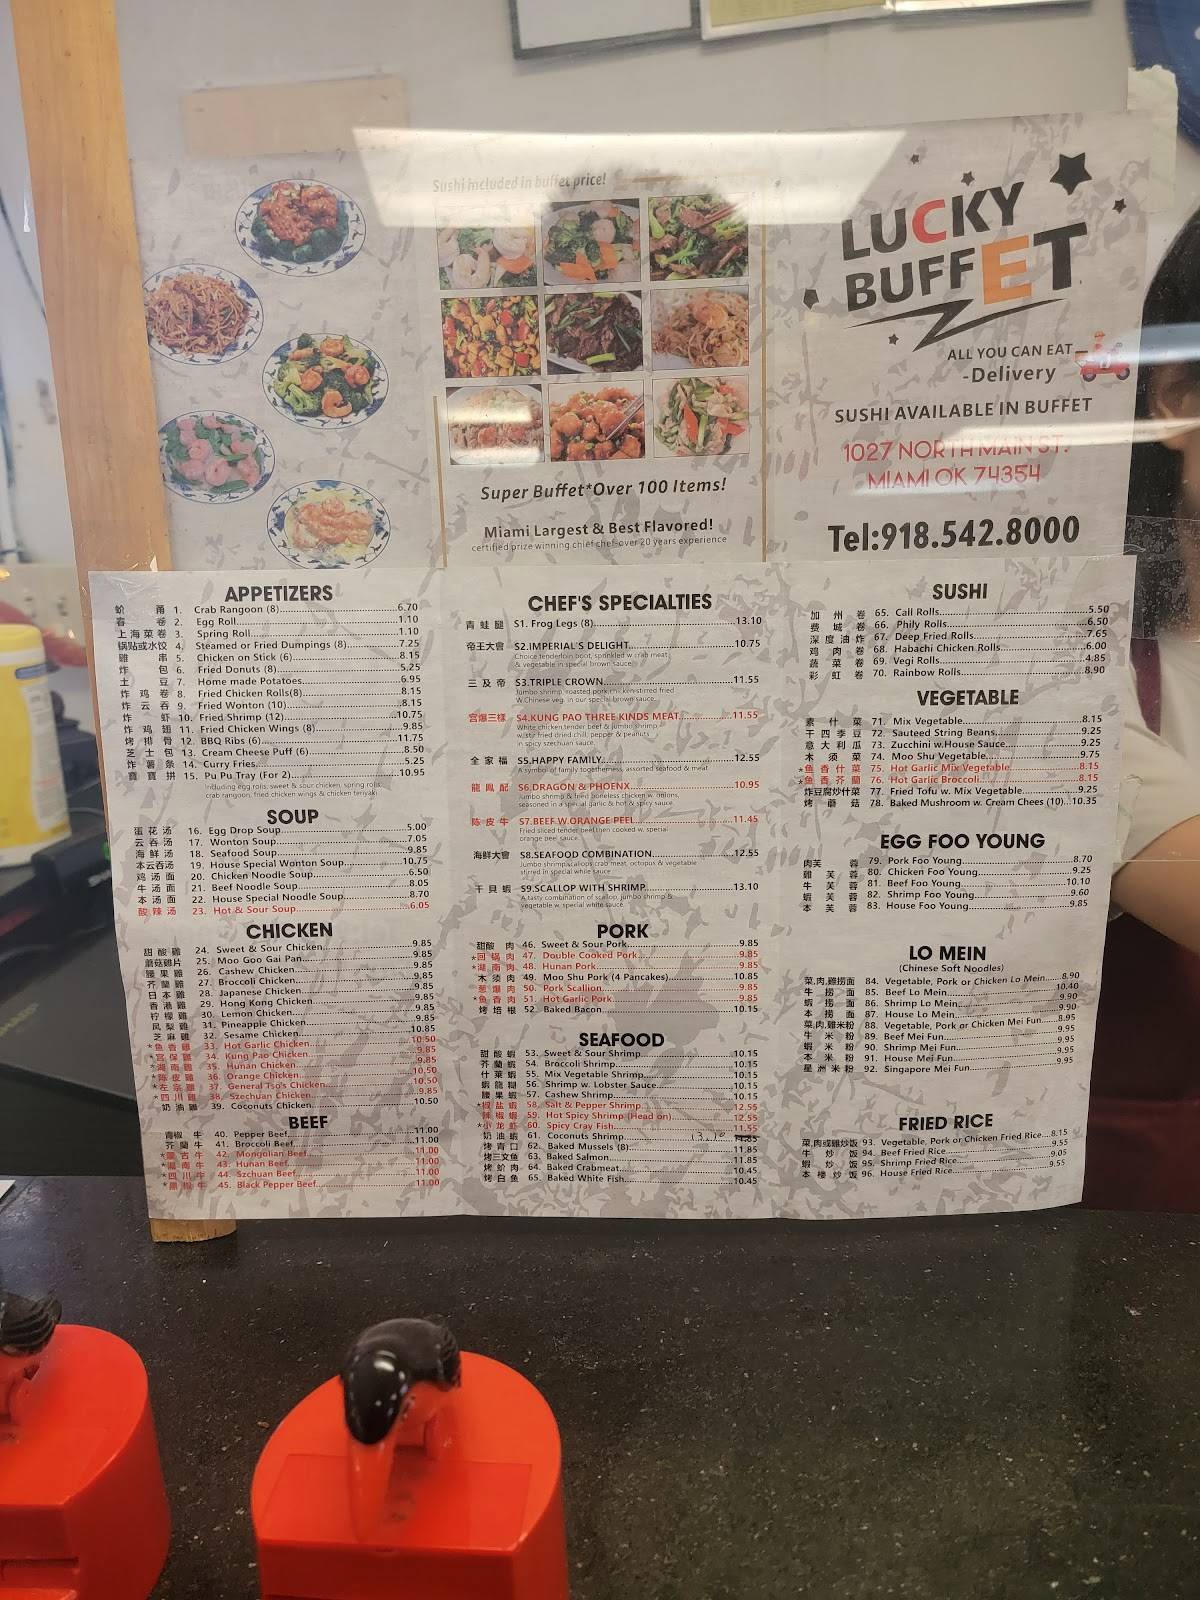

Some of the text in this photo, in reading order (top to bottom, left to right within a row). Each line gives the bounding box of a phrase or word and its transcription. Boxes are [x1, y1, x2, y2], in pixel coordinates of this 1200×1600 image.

[433, 178, 465, 193] Sushi
[467, 176, 518, 191] included
[521, 176, 532, 189] in
[573, 173, 607, 190] price!
[842, 182, 1024, 260] LUCKY
[846, 222, 1087, 312] BUFFET
[947, 344, 1073, 360] ALL YOU CAN EAT
[962, 366, 1056, 384] -Delivery
[834, 398, 1093, 422] SUSHI AVAILABLE IN BUFFET
[844, 441, 893, 462] 1027
[898, 438, 973, 460] NORTH
[979, 436, 1032, 456] MAIN
[868, 464, 1041, 489] MIAMI OK 74354
[481, 486, 528, 502] Super
[638, 480, 668, 494] 100
[673, 477, 727, 493] Items!
[484, 519, 713, 538] Miami Largest & Best Flavored!
[828, 515, 1080, 552] Tel:918.542.8000
[472, 543, 509, 552] certified
[511, 542, 532, 551] prize
[535, 541, 569, 550] winning
[572, 540, 594, 548] chief
[653, 538, 676, 547] years
[679, 535, 727, 546] experience
[225, 585, 334, 602] APPETIZERS
[932, 583, 988, 600] SUSHI
[174, 602, 418, 616] 1. Crab Rangoon (8) 6.70
[528, 593, 712, 612] CHEF'S SPECIALTIES
[514, 616, 762, 630] S1. Frog Legs (8) 13.10
[197, 629, 229, 640] Spring
[232, 628, 251, 638] Roll
[399, 627, 419, 636] 1.10
[874, 629, 1107, 643] 67. Deep Fried Rolls 7.65
[198, 676, 226, 686] Home
[230, 676, 259, 686] made
[261, 676, 302, 686] Potatoes
[401, 674, 421, 684] 6.95
[917, 689, 1019, 706] VEGETABLE
[872, 714, 1102, 728] 71. Mix Vegetable 8.15
[181, 734, 424, 746] 12. BBQ Ribs (6) 11.75
[568, 755, 602, 765] FAMILY
[734, 753, 760, 762] 12.55
[267, 810, 319, 825] SOUP
[189, 834, 427, 847] 17. Wonton Soup 7.05
[880, 833, 1045, 849] EGG FOO YOUNG
[581, 849, 652, 859] COMBINATION
[734, 849, 759, 858] 12.55
[868, 866, 1091, 878] 80. Chicken Foo Young 9.25
[246, 922, 333, 939] CHICKEN
[597, 924, 648, 939] PORK
[522, 939, 759, 950] 46. Sweet & Sour Pork 9.85
[909, 946, 986, 961] LO MEIN
[197, 960, 433, 976] 26. Cashew Chicken 9.85
[899, 963, 1004, 974] (Chinese Soft Noodles)
[579, 1033, 665, 1047] SEAFOOD
[864, 1035, 1075, 1054] 90. Shrimp Mei Fun 9.95
[231, 1102, 273, 1111] Coconuts
[276, 1101, 312, 1110] Chicken
[414, 1097, 439, 1106] 10.50
[289, 1116, 328, 1130] BEEF
[899, 1114, 993, 1131] FRIED RICE
[215, 1126, 439, 1140] 40. Pepper Beef 11.00
[881, 1148, 900, 1157] Beef
[903, 1148, 926, 1156] Fried
[928, 1147, 946, 1155] Rice
[1051, 1138, 1068, 1147] 9.55
[237, 1180, 261, 1189] Black
[263, 1180, 296, 1191] Pepper
[297, 1179, 318, 1189] Beef
[415, 1178, 440, 1187] 11.00
[528, 1173, 758, 1185] 65. Baked White Fish 10.45
